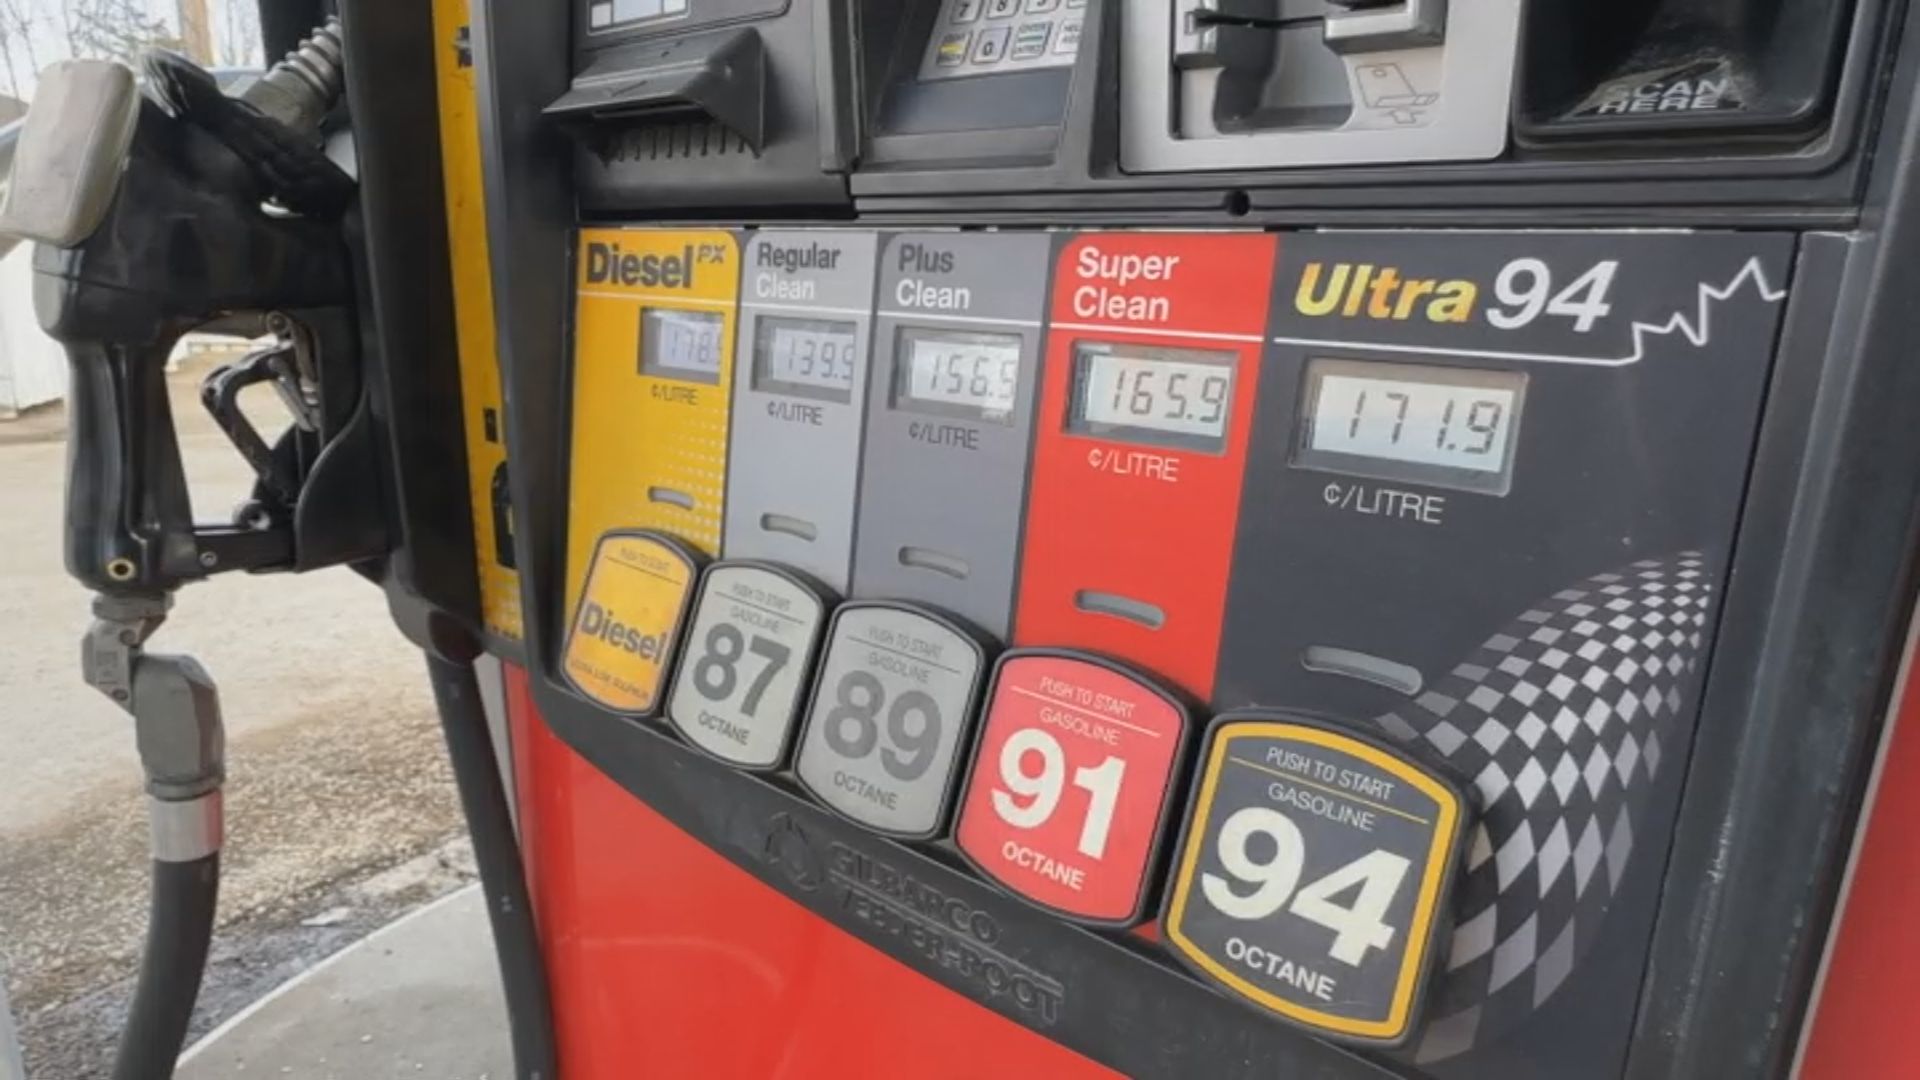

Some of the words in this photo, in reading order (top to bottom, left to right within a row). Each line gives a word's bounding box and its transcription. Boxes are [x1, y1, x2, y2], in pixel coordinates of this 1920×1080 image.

[1598, 96, 1719, 114] HERE
[586, 242, 692, 288] Diesel
[696, 244, 726, 264] PX
[757, 242, 841, 273] Regular
[898, 243, 954, 273] Plus
[1076, 246, 1180, 286] Super
[756, 272, 815, 299] Clean
[896, 278, 970, 310] Clean
[1073, 286, 1169, 321] Clean
[1294, 262, 1478, 322] Ultra
[1485, 257, 1620, 332] 94
[767, 402, 824, 425] ¢/LITRE
[1112, 368, 1228, 423] 165.9
[908, 421, 979, 450] ¢/LITRE
[1349, 389, 1503, 455] 171.9
[1087, 449, 1180, 481] ¢/LITRE
[1323, 482, 1446, 524] ¢/LITRE
[581, 601, 668, 664] Diesel
[730, 604, 780, 633] GASOLINE
[693, 622, 791, 718] 87
[868, 651, 931, 684] GASOLINE
[1040, 676, 1075, 697] PUSH
[1076, 686, 1093, 706] TO
[1093, 691, 1136, 718] START
[698, 710, 750, 746] OCTANE
[823, 670, 942, 782] 89
[1040, 707, 1121, 746] GASOLINE
[833, 770, 898, 811] OCTANE
[990, 727, 1127, 860] 91
[1266, 746, 1311, 776] PUSH
[1314, 761, 1337, 784] TO
[1338, 768, 1396, 800] START
[1268, 782, 1377, 833] GASOLINE
[1002, 840, 1087, 891] OCTANE
[1202, 806, 1412, 968] 94
[1225, 937, 1337, 1001] OCTANE
